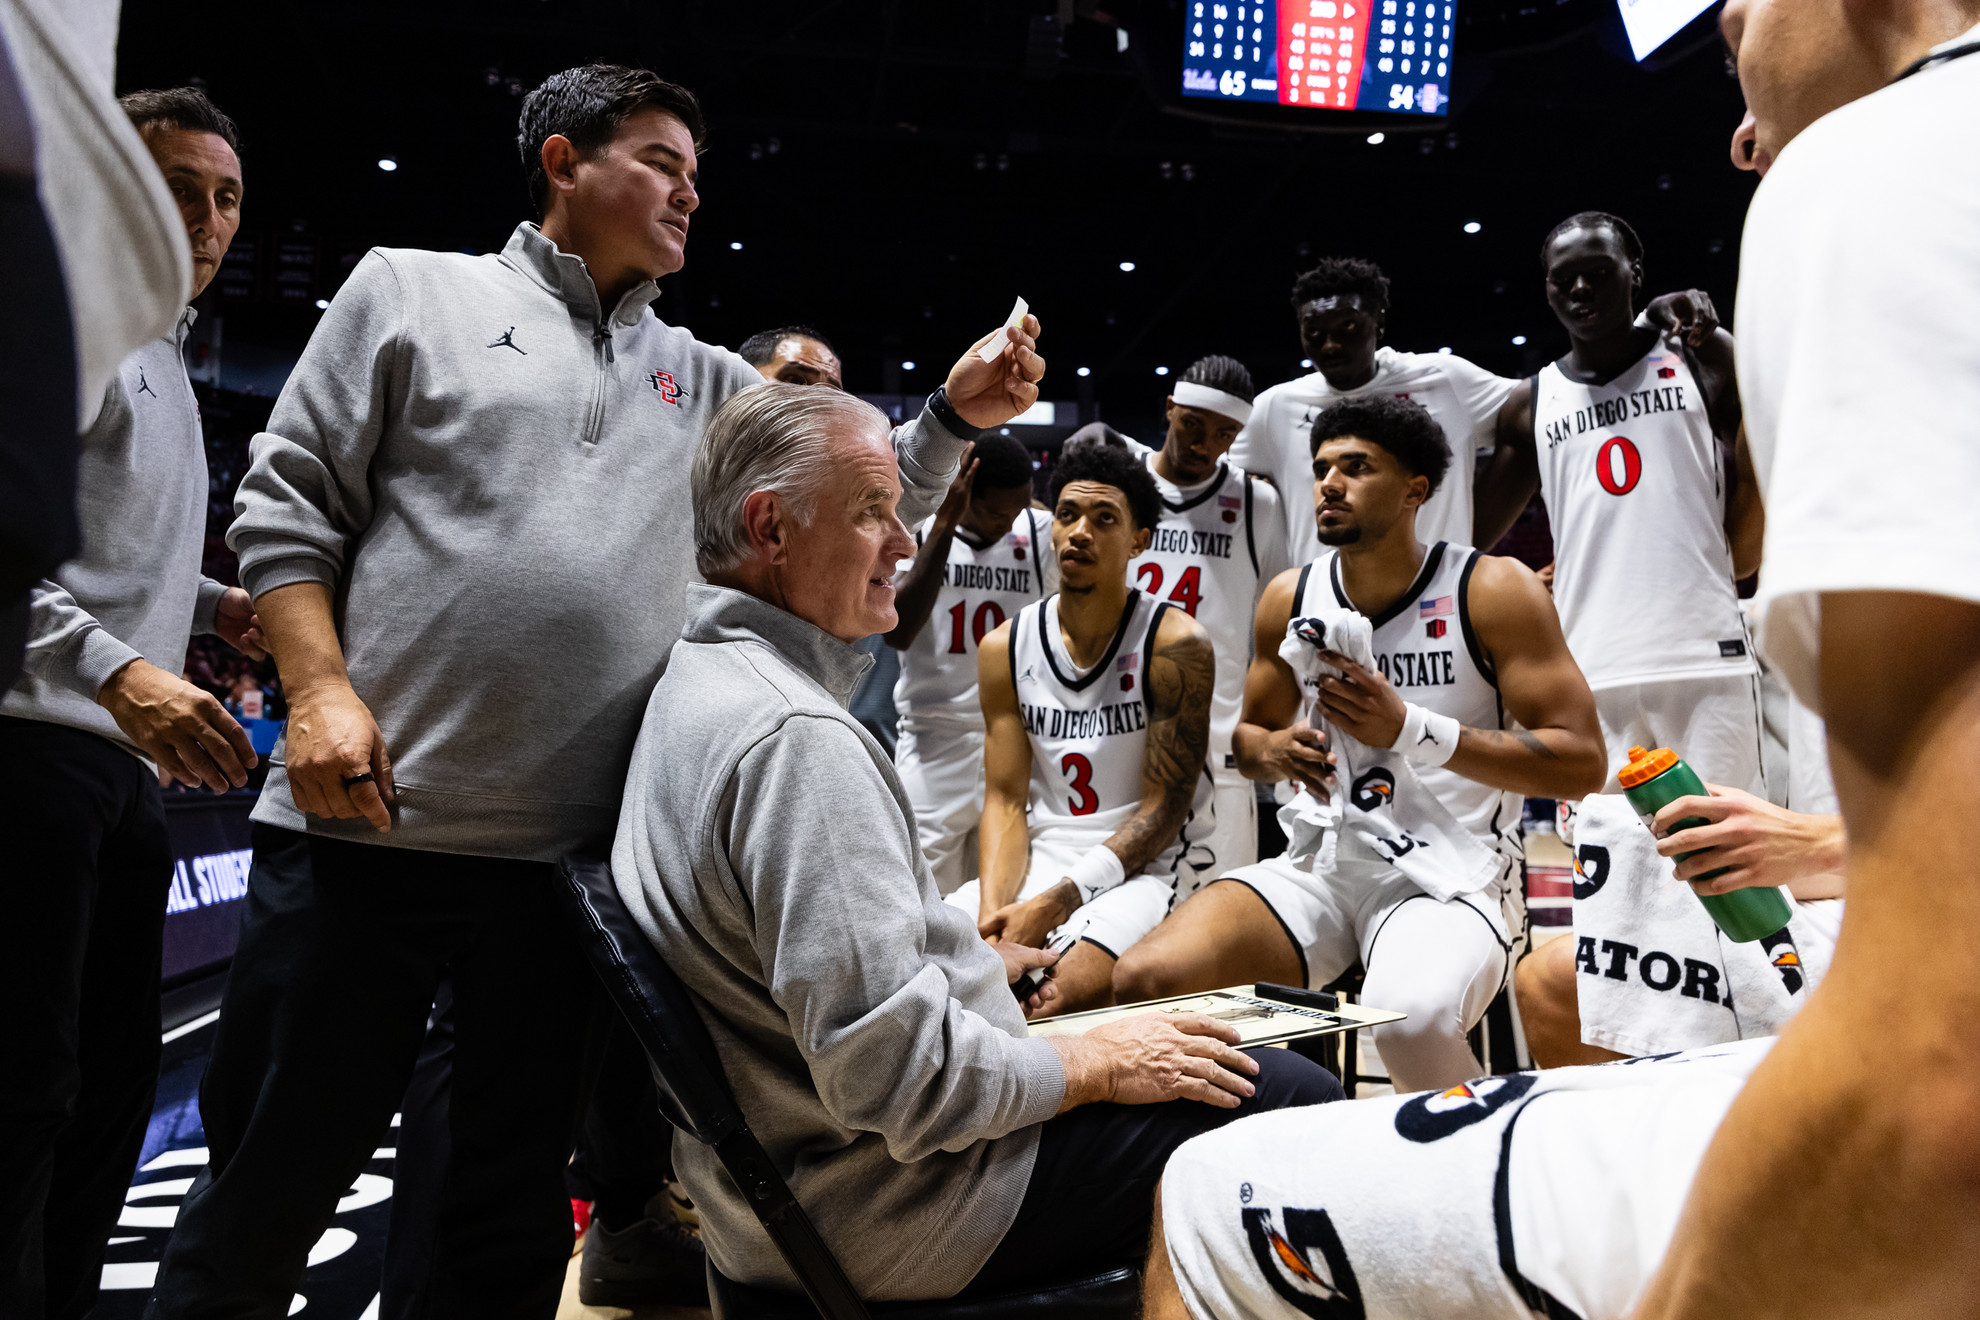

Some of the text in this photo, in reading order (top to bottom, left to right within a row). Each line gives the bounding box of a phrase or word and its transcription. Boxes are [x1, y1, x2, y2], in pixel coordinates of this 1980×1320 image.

[1219, 70, 1246, 96] 65
[1388, 84, 1414, 110] 54
[1545, 386, 1687, 448] SAN DIEGO STATE
[1596, 436, 1642, 496] 0
[1153, 529, 1233, 559] IEGO STATE
[954, 564, 993, 590] DIEGO
[995, 567, 1030, 594] STATE
[1137, 562, 1204, 619] 24
[948, 598, 1007, 654] 10
[1393, 651, 1456, 687] STATE
[1021, 701, 1146, 739] SAN DIEGO STATE
[1061, 752, 1099, 816] 3
[1575, 935, 1735, 1011] ATOR
